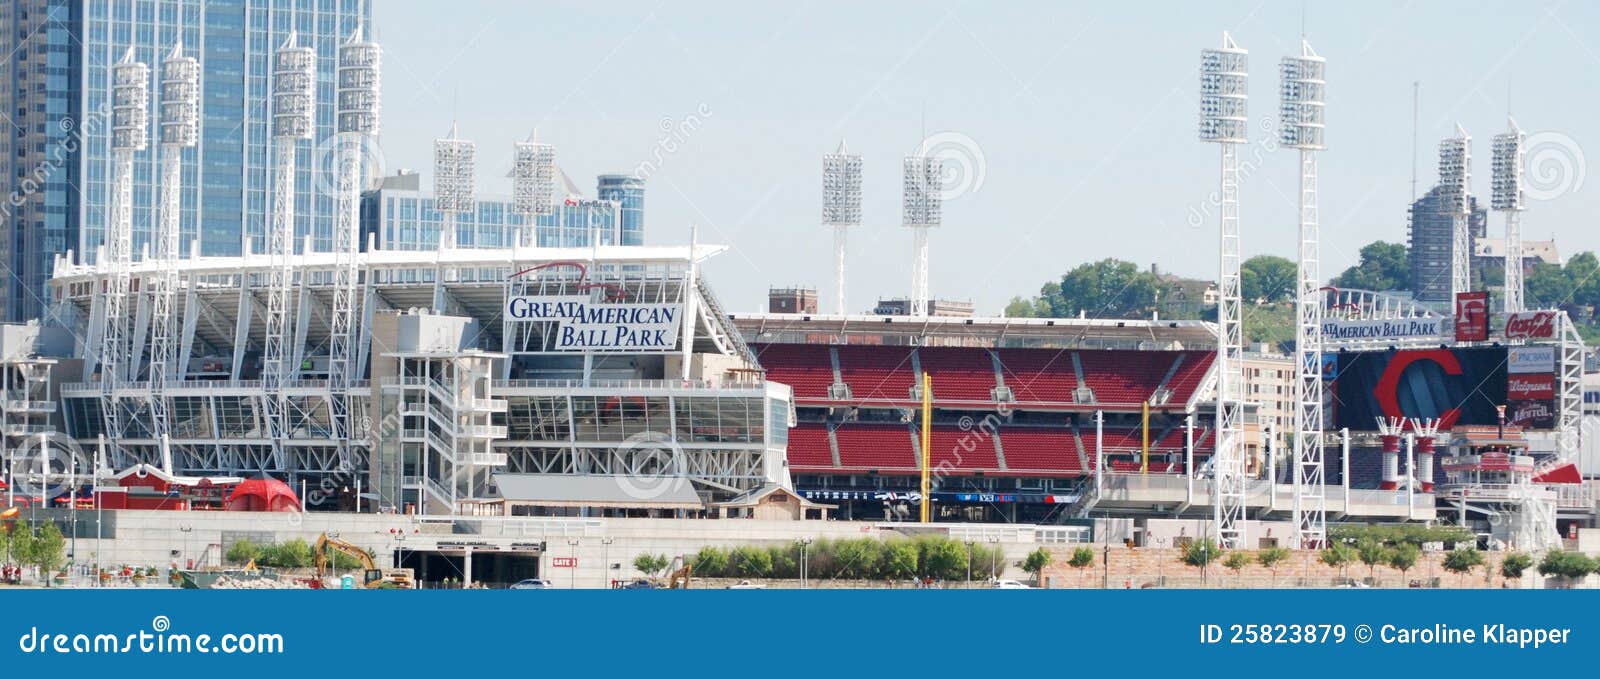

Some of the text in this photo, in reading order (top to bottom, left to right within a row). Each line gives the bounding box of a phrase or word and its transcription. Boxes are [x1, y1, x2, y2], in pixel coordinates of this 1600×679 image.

[509, 297, 676, 324] GREAT AMERICAN
[560, 325, 668, 347] BALL PARK
[1331, 323, 1381, 338] AMERICAN
[1382, 322, 1409, 337] BALL
[1409, 321, 1438, 336] PARK
